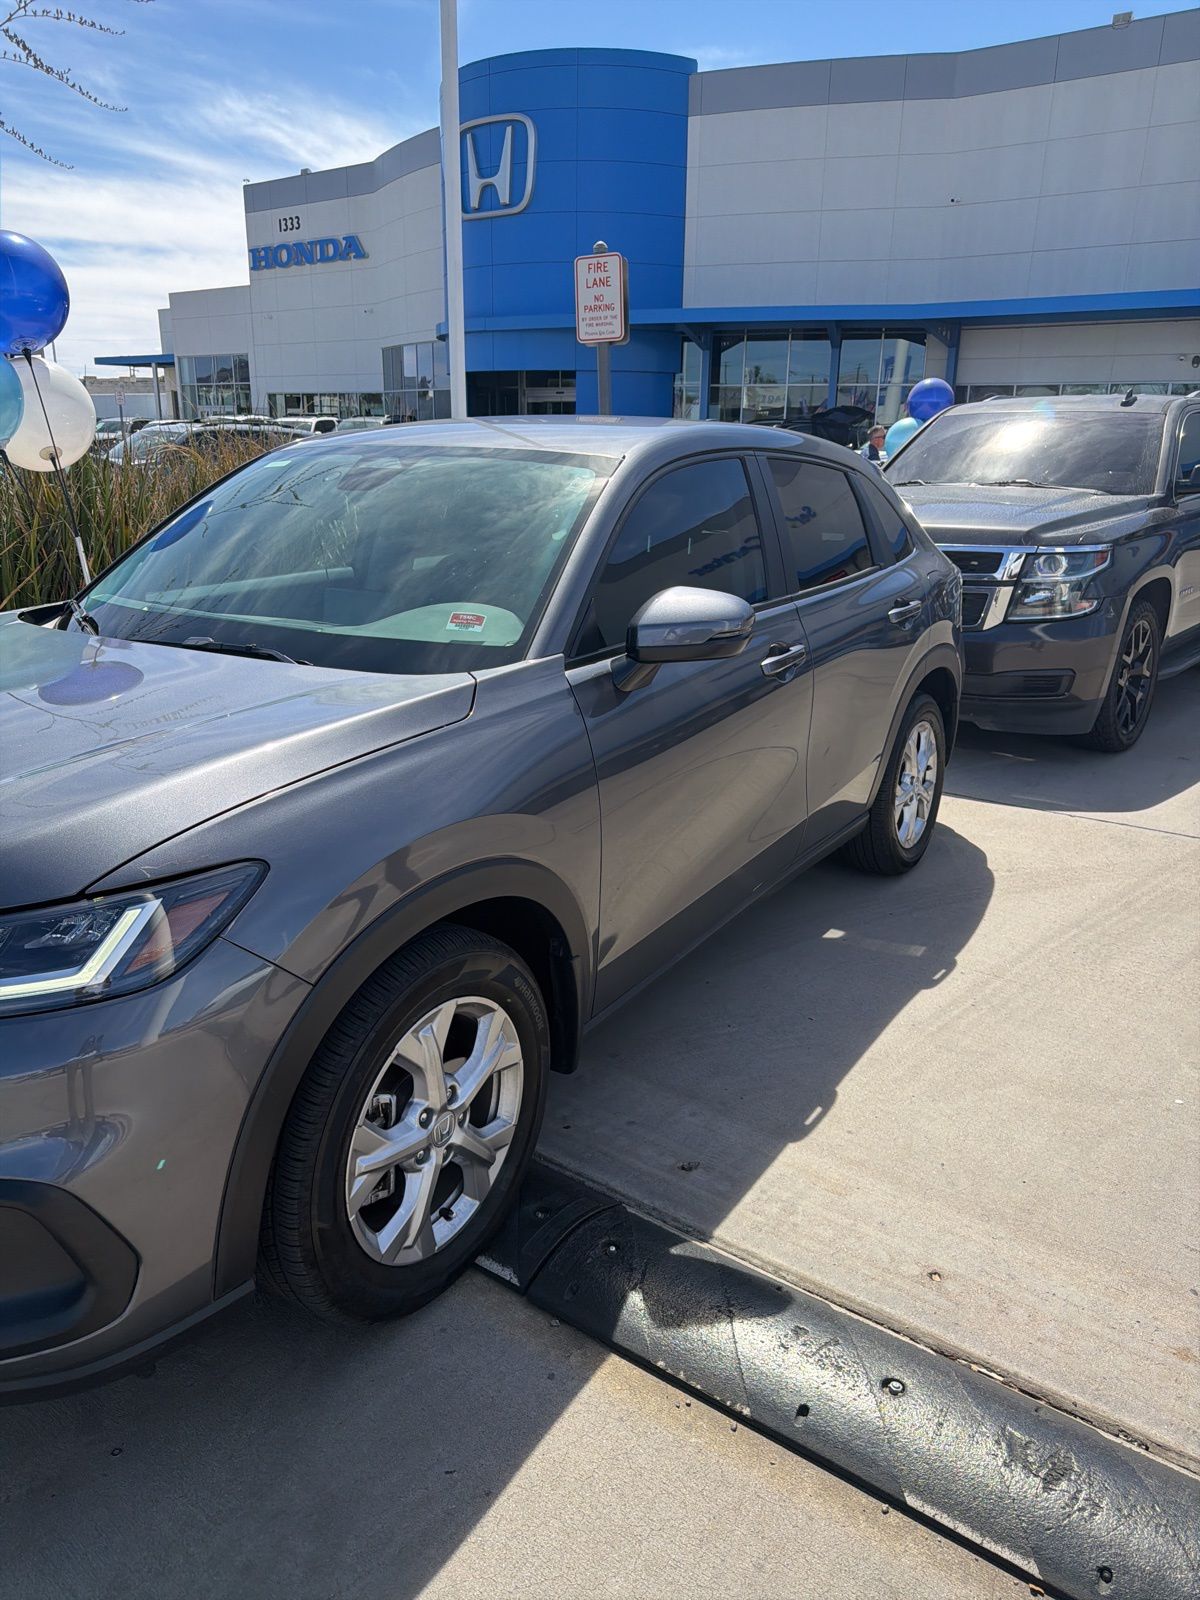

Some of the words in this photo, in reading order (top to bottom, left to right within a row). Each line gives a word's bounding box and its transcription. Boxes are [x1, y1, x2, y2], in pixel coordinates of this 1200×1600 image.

[278, 215, 301, 233] 1333
[249, 234, 369, 271] HONDA
[587, 261, 609, 274] FIRE
[585, 276, 612, 289] LANE
[593, 294, 605, 303] NO
[583, 303, 616, 313] PARKING
